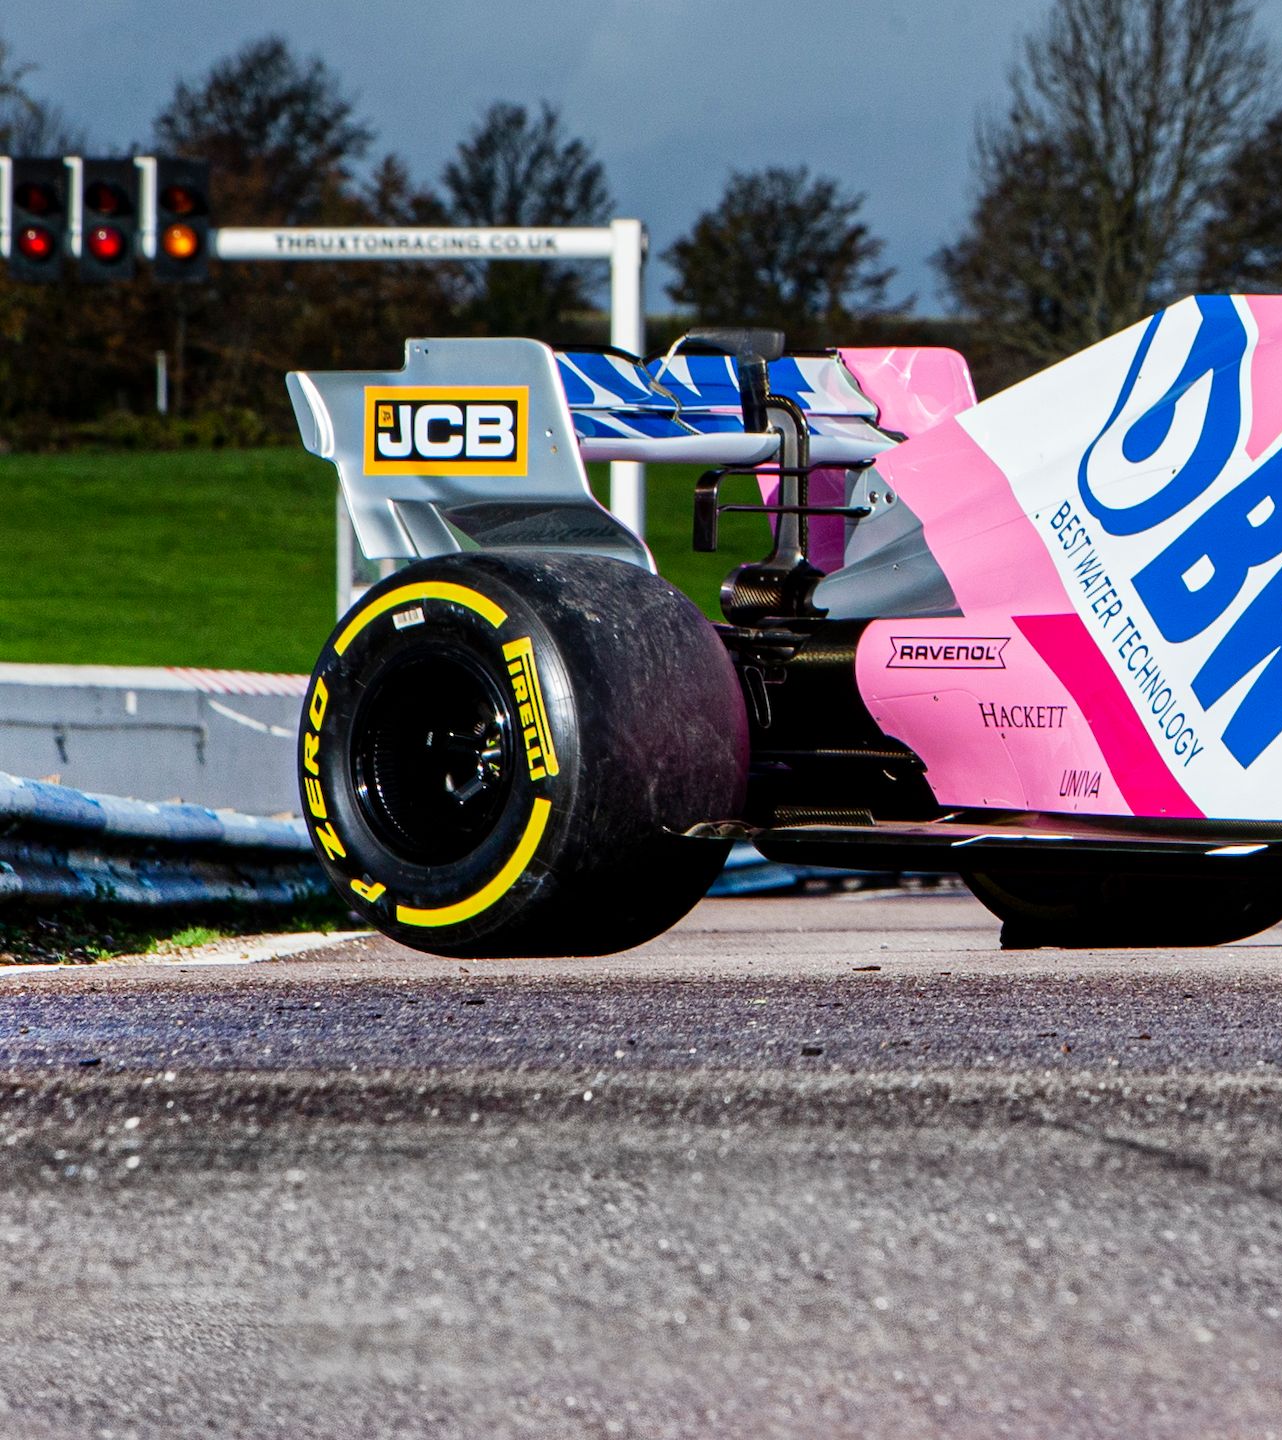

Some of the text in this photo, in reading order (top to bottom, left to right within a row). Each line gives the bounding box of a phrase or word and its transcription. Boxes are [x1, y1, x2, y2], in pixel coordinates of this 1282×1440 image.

[275, 234, 559, 253] THRUXTONRACING.CO.UK
[377, 404, 515, 457] JCB
[900, 646, 995, 660] RAVENOL
[1050, 500, 1204, 768] BEST WATER TECHNOLOGY
[502, 636, 560, 781] PIRELLI
[978, 703, 1068, 728] HACKETT
[304, 676, 347, 861] ZERO
[1059, 770, 1102, 798] UNIVA
